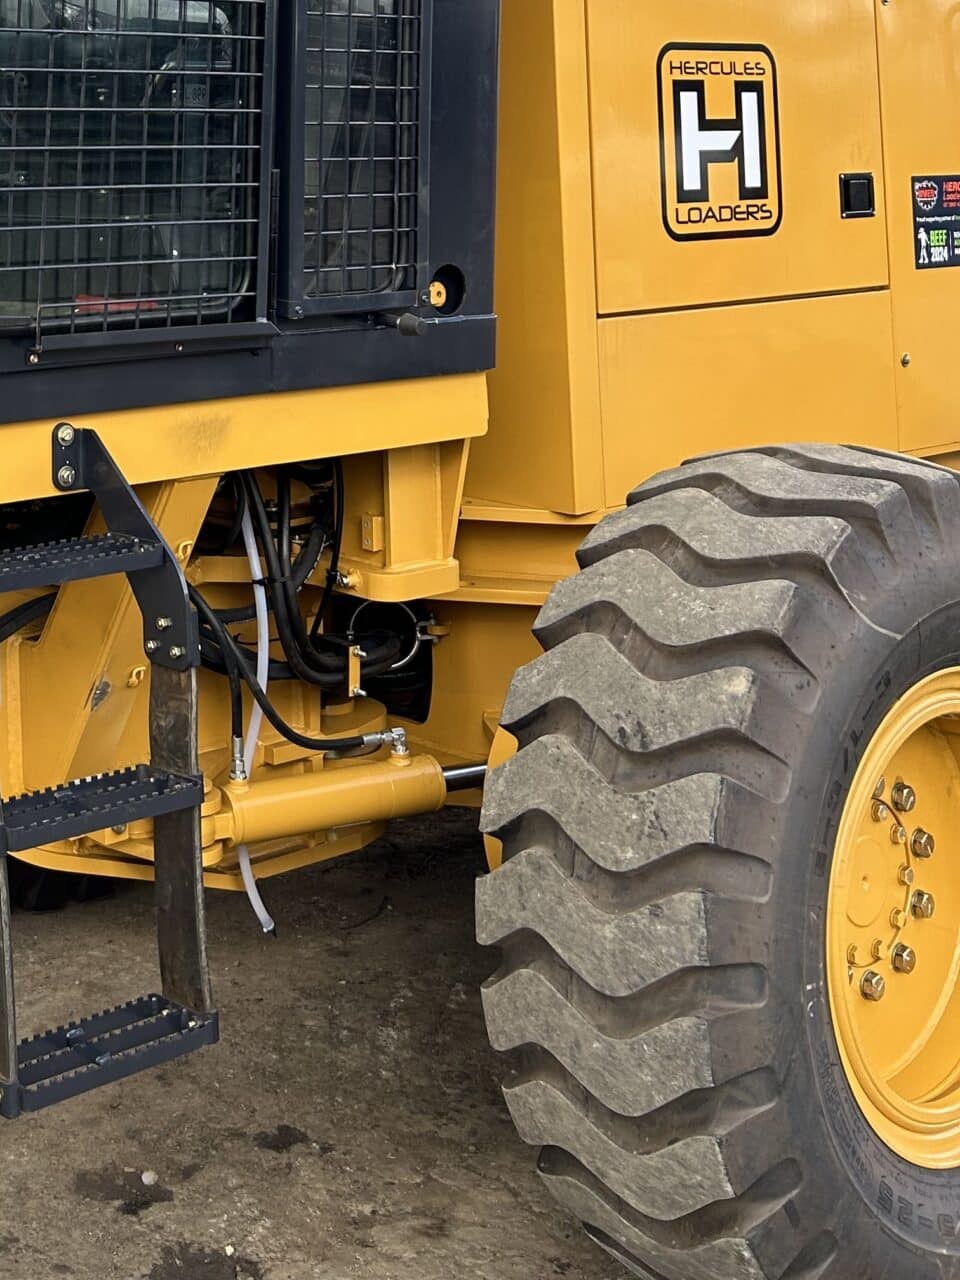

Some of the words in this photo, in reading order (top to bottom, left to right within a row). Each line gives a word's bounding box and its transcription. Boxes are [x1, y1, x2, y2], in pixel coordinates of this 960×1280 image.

[669, 61, 766, 76] HERCULES
[675, 203, 773, 225] LOADERS
[930, 230, 947, 247] BEEF
[930, 246, 948, 262] 2024
